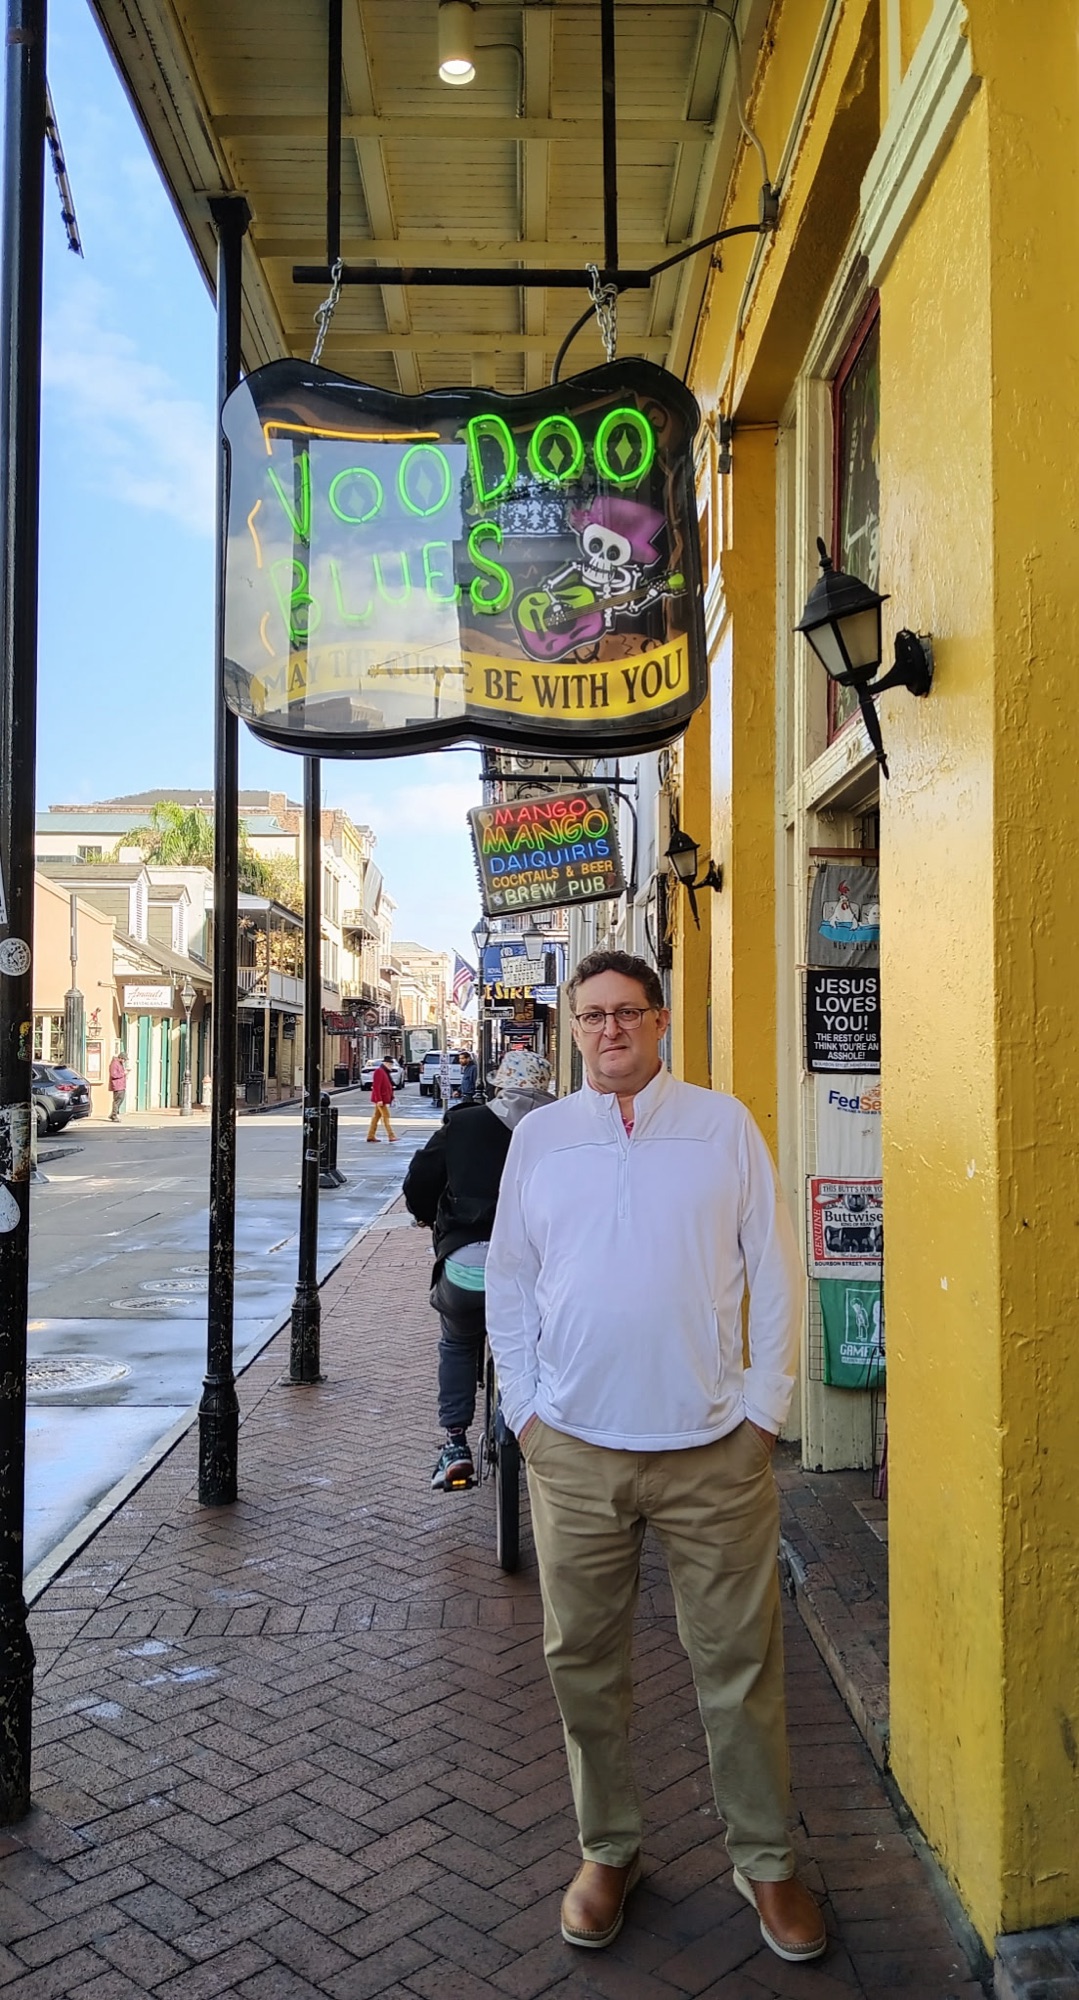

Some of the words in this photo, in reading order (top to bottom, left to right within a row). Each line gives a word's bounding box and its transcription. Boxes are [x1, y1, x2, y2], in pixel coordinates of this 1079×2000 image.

[267, 407, 656, 547] VOODOO
[270, 518, 514, 644] BLUES
[263, 655, 321, 697] MAY
[328, 648, 374, 679] THE
[484, 668, 524, 702] BE
[531, 672, 609, 709] WITH
[621, 648, 683, 704] YOU
[495, 799, 587, 826] MANGO
[483, 809, 609, 854] MANGO
[490, 839, 610, 874] DAIQUIRIS
[492, 867, 560, 888] COCKTAILS
[566, 865, 575, 878] &
[581, 860, 614, 875] BEER
[504, 881, 557, 906] BREW
[568, 876, 606, 896] PUB
[815, 977, 877, 995] JESUS
[815, 996, 877, 1013] LOVES
[823, 1014, 868, 1031] YOU!
[813, 1041, 838, 1051] THINK
[838, 1042, 867, 1051] YOU'RE
[867, 1042, 879, 1051] AN
[816, 1032, 832, 1042] THE
[833, 1033, 853, 1042] REST
[853, 1033, 865, 1042] OF
[865, 1033, 877, 1042] US
[827, 1051, 866, 1060] ASSHOLE!
[813, 1208, 824, 1256] GENUINE
[840, 1343, 868, 1357] GAME
